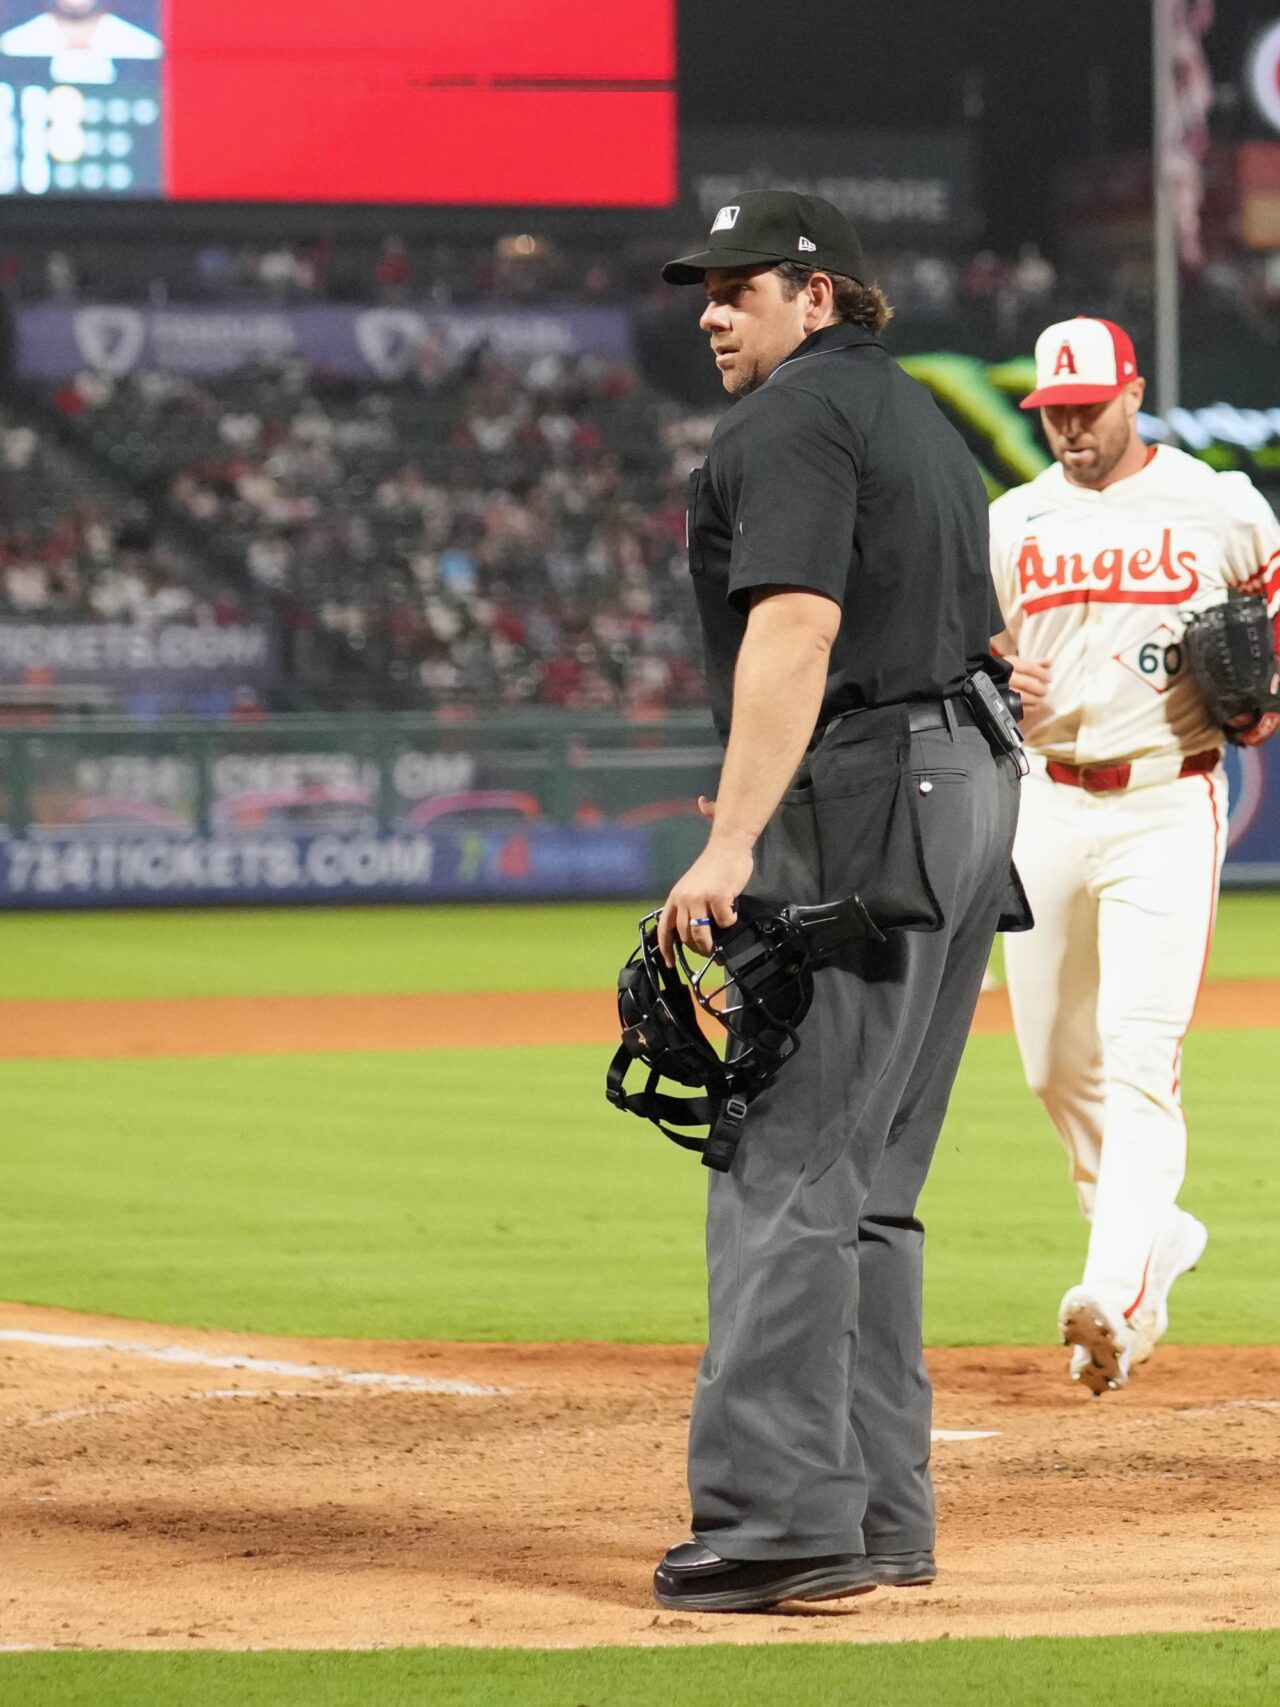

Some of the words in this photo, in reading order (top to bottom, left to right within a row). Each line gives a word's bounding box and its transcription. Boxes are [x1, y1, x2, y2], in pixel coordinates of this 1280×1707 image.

[1053, 340, 1077, 376] A
[1018, 527, 1199, 614] Angels
[1138, 641, 1184, 676] 60
